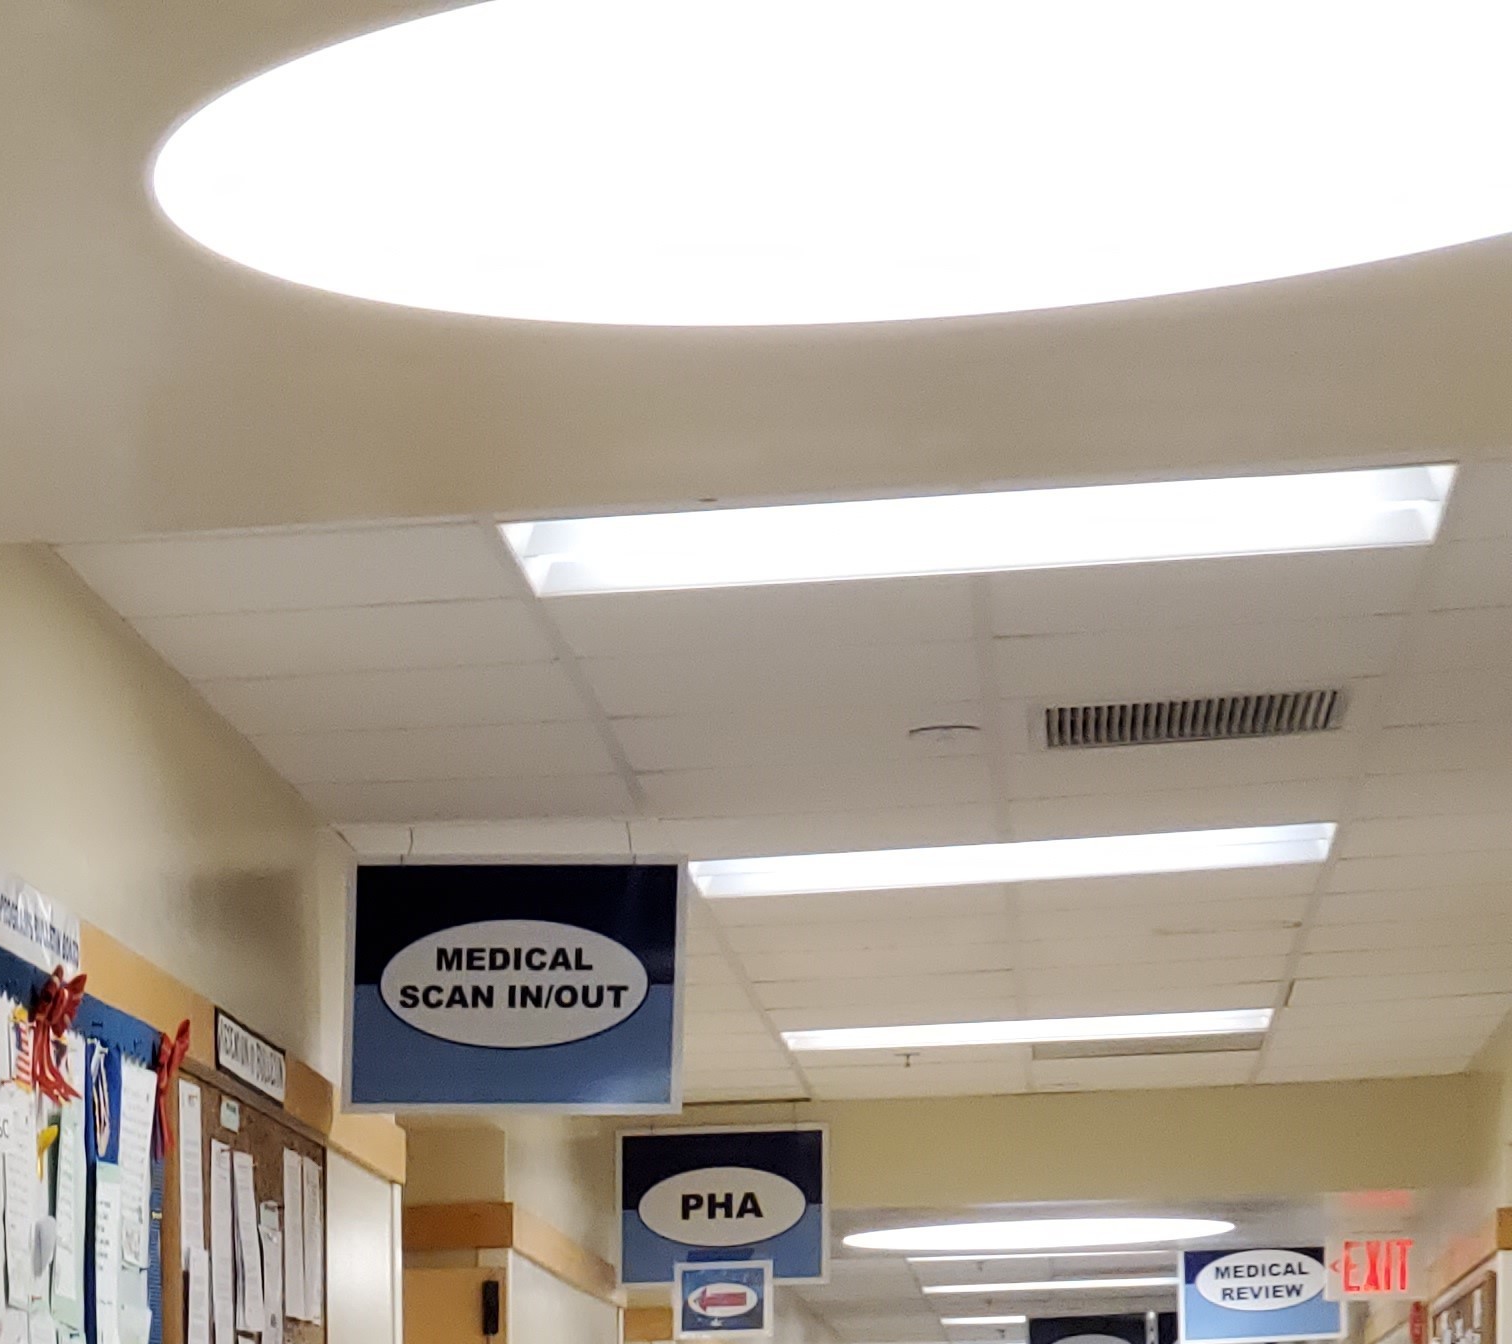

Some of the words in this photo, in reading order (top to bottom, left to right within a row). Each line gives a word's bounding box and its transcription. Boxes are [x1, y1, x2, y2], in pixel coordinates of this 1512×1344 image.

[435, 946, 594, 972] MEDICAL
[399, 984, 494, 1010] SCAN
[508, 984, 629, 1010] IN/OUT
[680, 1192, 764, 1221] PHA
[1214, 1261, 1310, 1281] MEDICAL
[1342, 1238, 1414, 1294] EXIT
[1221, 1283, 1305, 1302] REVIEW
